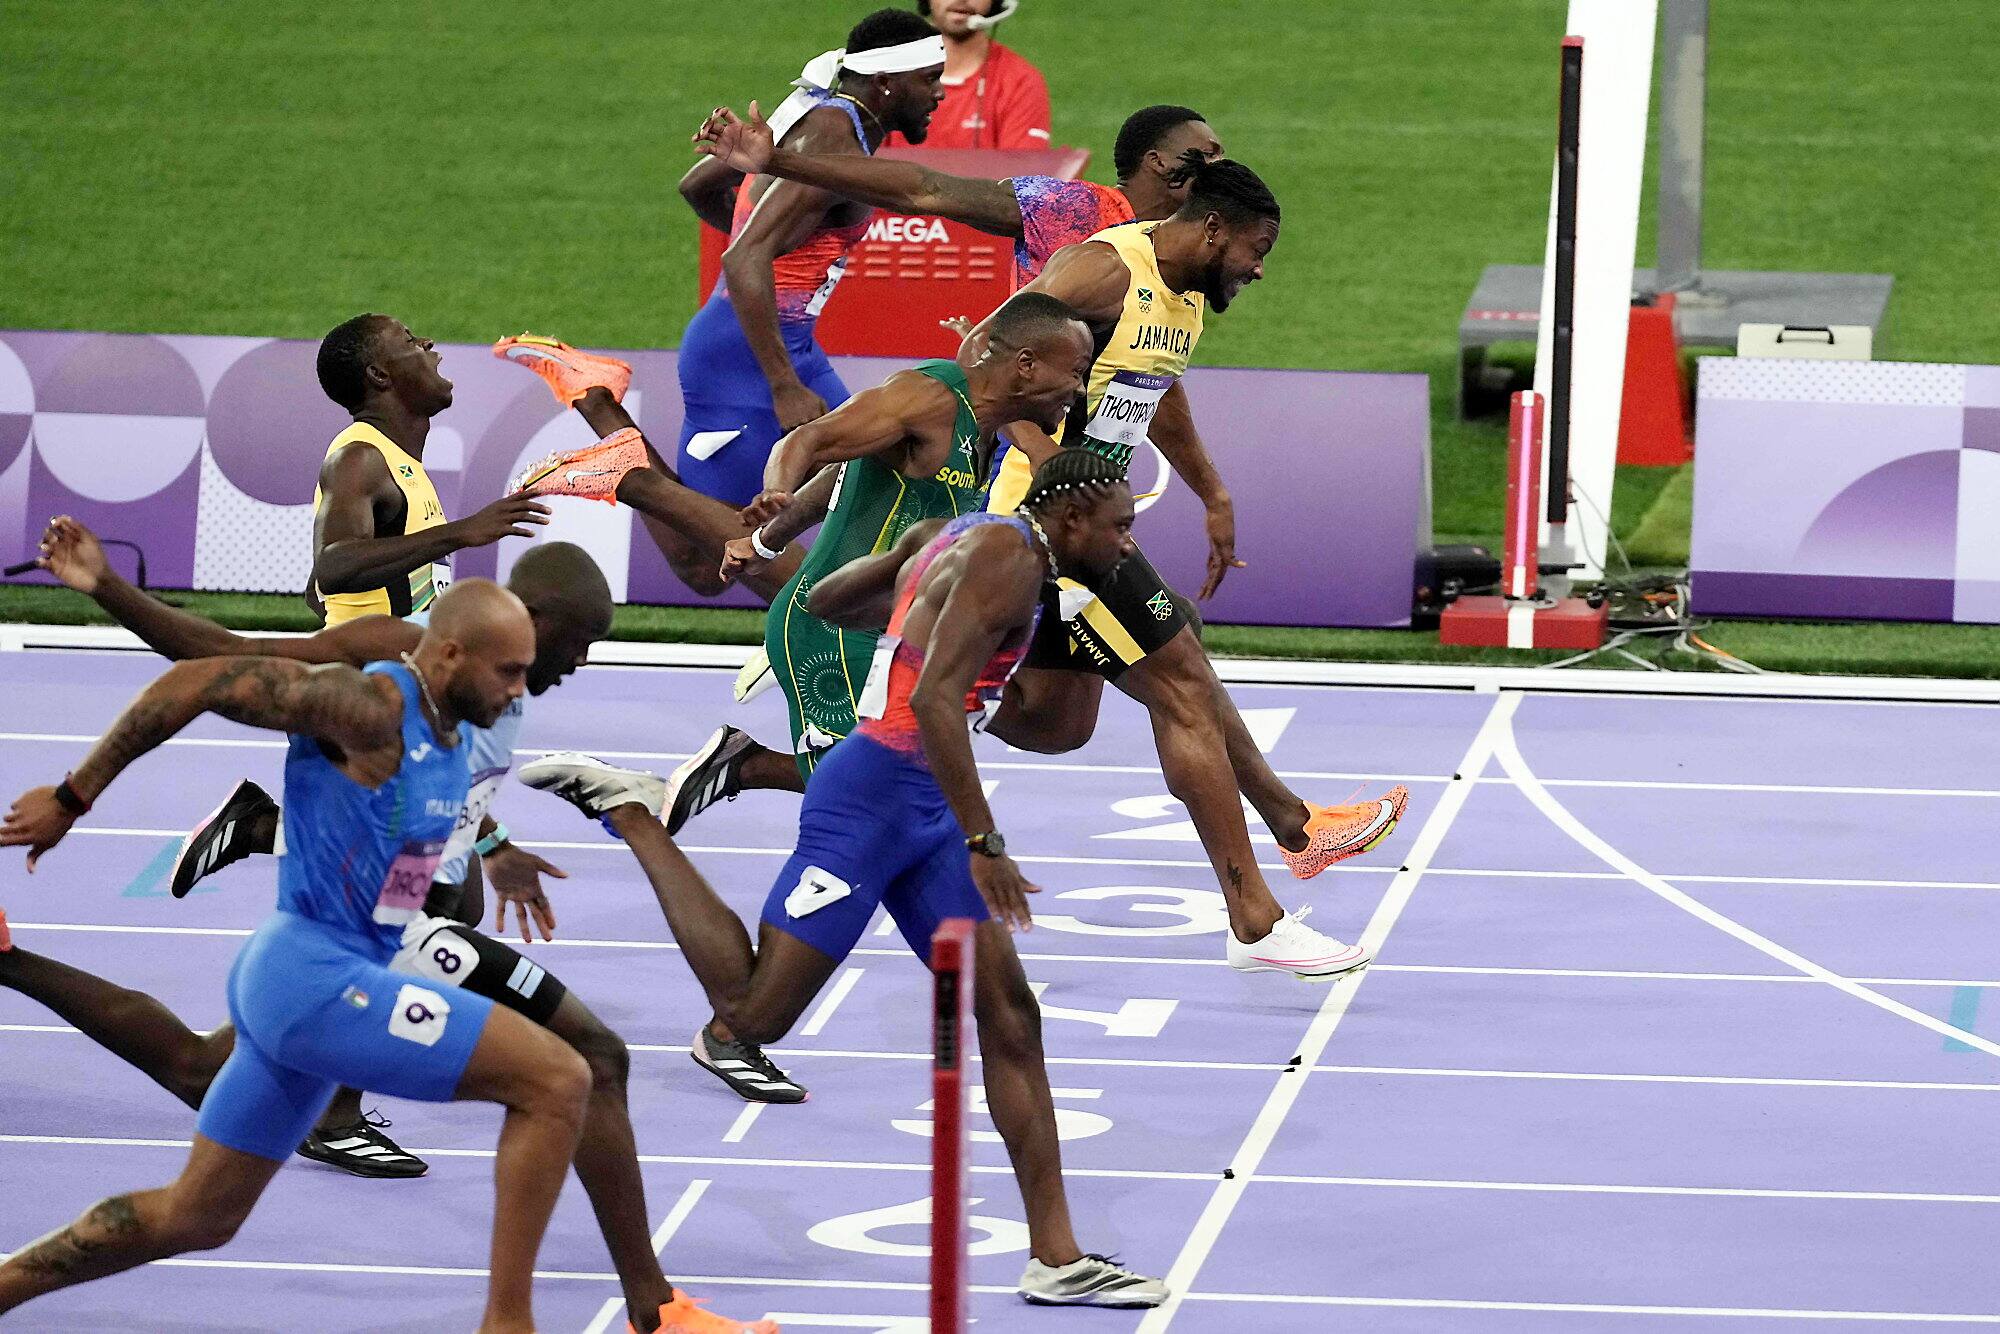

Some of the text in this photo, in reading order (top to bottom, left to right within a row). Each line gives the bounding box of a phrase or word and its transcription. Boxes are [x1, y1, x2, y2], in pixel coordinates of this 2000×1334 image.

[861, 217, 949, 243] MEGA
[1130, 325, 1191, 356] JAMAICA
[1090, 794, 1279, 845] 2
[1029, 886, 1231, 937] 3
[433, 947, 461, 974] 8
[405, 1003, 435, 1024] 9
[805, 1195, 1032, 1258] 6
